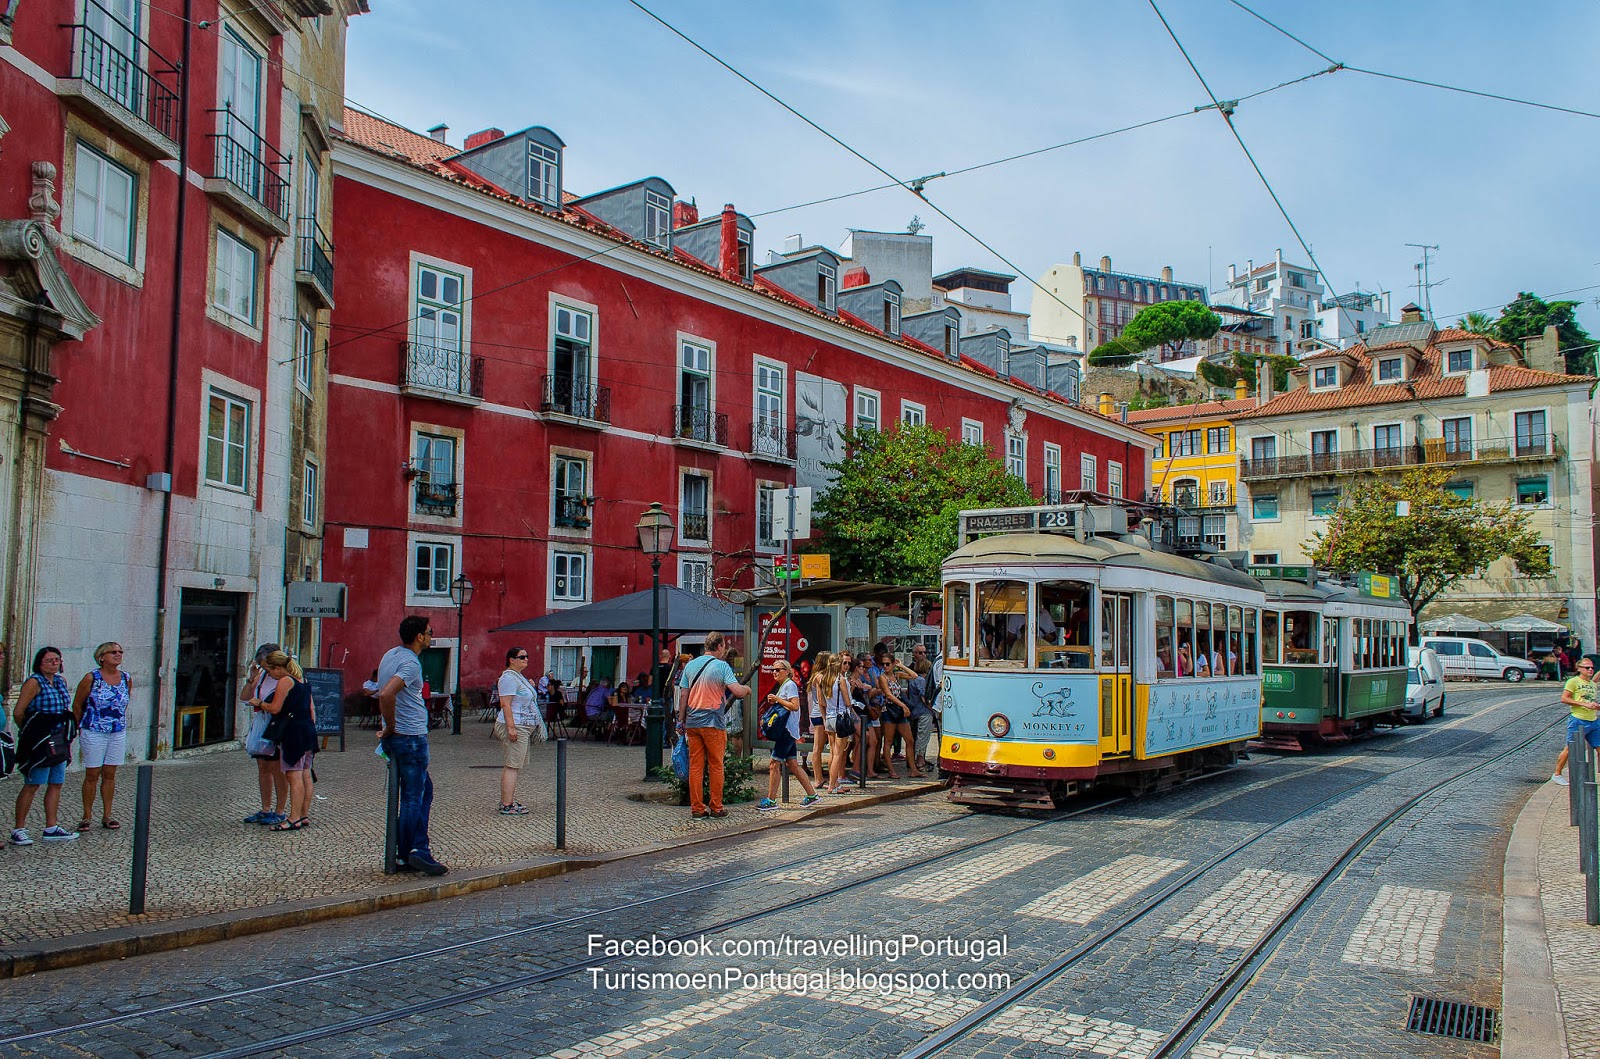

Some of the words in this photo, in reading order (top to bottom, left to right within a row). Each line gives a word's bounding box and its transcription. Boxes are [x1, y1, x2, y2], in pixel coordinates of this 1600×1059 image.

[970, 514, 1026, 528] PRAZERES
[1045, 511, 1068, 527] 28
[1256, 568, 1271, 576] TOUR
[1263, 673, 1283, 684] TOUR
[1022, 722, 1072, 731] MONKEY
[1074, 723, 1085, 731] 47
